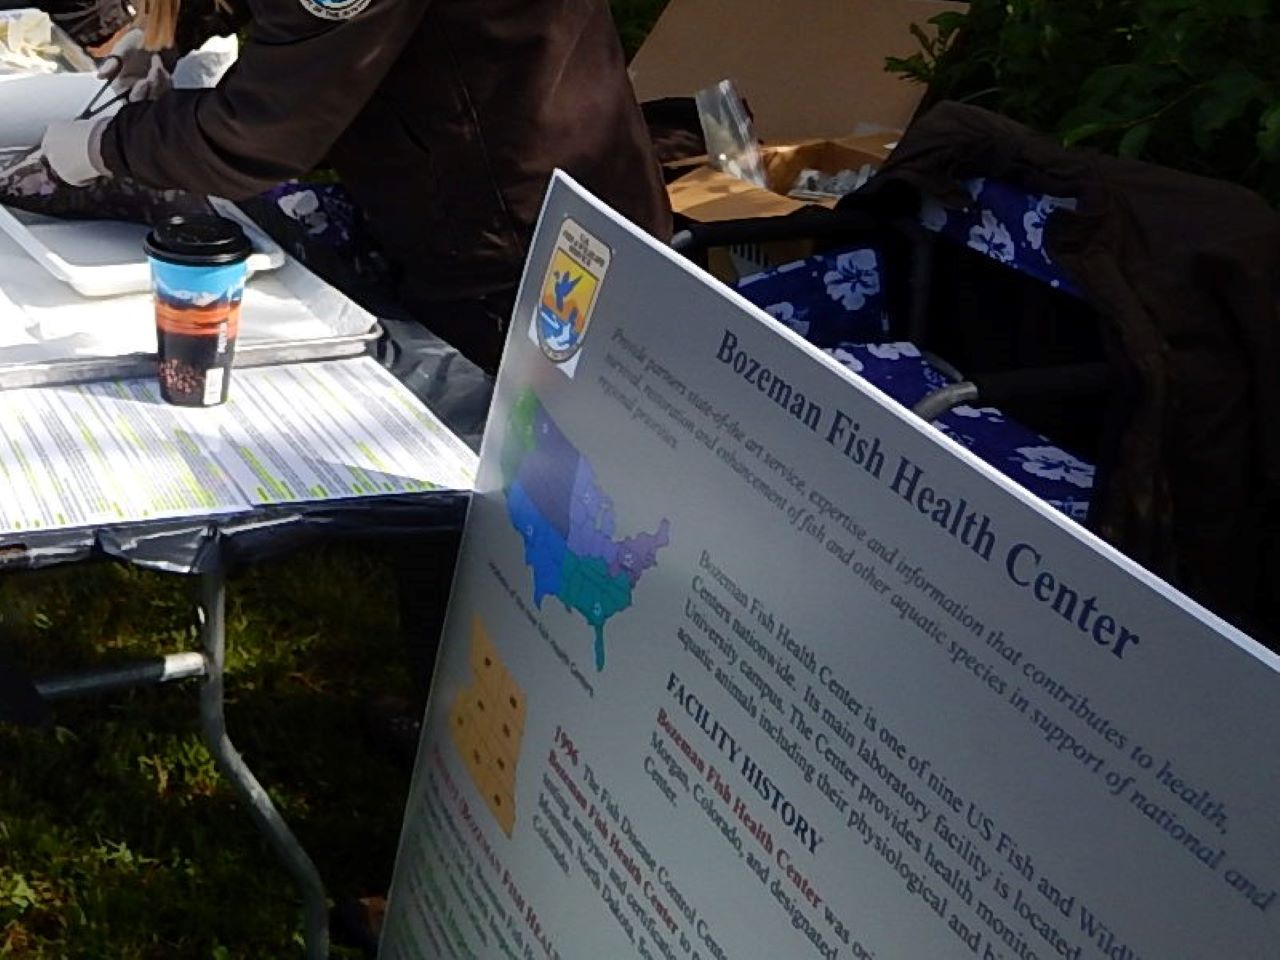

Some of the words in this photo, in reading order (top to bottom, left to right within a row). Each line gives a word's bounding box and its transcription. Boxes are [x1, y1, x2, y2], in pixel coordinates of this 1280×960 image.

[715, 330, 822, 433] Bozeman
[825, 410, 885, 480] Fish
[888, 456, 996, 562] Health
[1006, 543, 1140, 660] Center
[745, 437, 764, 458] art
[764, 453, 807, 495] service,
[809, 490, 867, 542] expertise
[867, 538, 899, 565] and
[896, 557, 984, 637] information
[986, 631, 1023, 667] that
[1023, 662, 1128, 750] contributes
[1130, 745, 1154, 770] to
[1156, 760, 1228, 836] health,
[657, 707, 705, 773] Bozeman
[705, 766, 731, 805] Fish
[732, 795, 774, 855] Health
[776, 848, 822, 910] Center
[824, 905, 849, 945] was
[666, 672, 742, 764] FACILITY
[741, 754, 824, 855] HISTORY
[677, 627, 714, 672] aquatic
[714, 666, 758, 719] animals
[758, 710, 815, 783] including
[816, 771, 849, 814] their
[847, 809, 948, 918] physiological
[948, 914, 982, 954] and
[685, 597, 738, 667] University
[740, 660, 786, 715] campus.
[789, 703, 814, 741] The
[815, 732, 859, 787] Center
[858, 784, 921, 853] provides
[924, 842, 973, 906] health
[692, 575, 731, 625] Centers
[732, 618, 797, 691] nationwide.
[803, 685, 821, 713] Its
[821, 709, 855, 748] main
[857, 739, 931, 823] laboratory
[933, 814, 991, 882] facility
[993, 871, 1009, 900] is
[695, 428, 719, 451] and
[716, 444, 787, 511] enhancement
[786, 505, 806, 526] of
[797, 513, 826, 544] fish
[826, 538, 856, 566] and
[852, 560, 891, 595] other
[890, 593, 947, 643] aquatic
[948, 639, 1007, 696] species
[1009, 687, 1030, 713] in
[1030, 708, 1104, 774] support
[1105, 770, 1136, 796] of
[1129, 789, 1226, 870] national
[1224, 868, 1277, 912] and
[699, 549, 748, 608] Bozeman
[750, 597, 775, 633] Fish
[776, 623, 817, 674] Health
[819, 665, 863, 716] Center
[864, 707, 877, 732] is
[879, 727, 907, 759] one
[908, 755, 931, 778] of
[927, 771, 964, 814] nine
[967, 801, 994, 841] US
[996, 831, 1036, 882] Fish
[1037, 877, 1075, 917] and
[643, 880, 679, 935] Center
[693, 783, 744, 858] Colorado,
[746, 852, 770, 885] and
